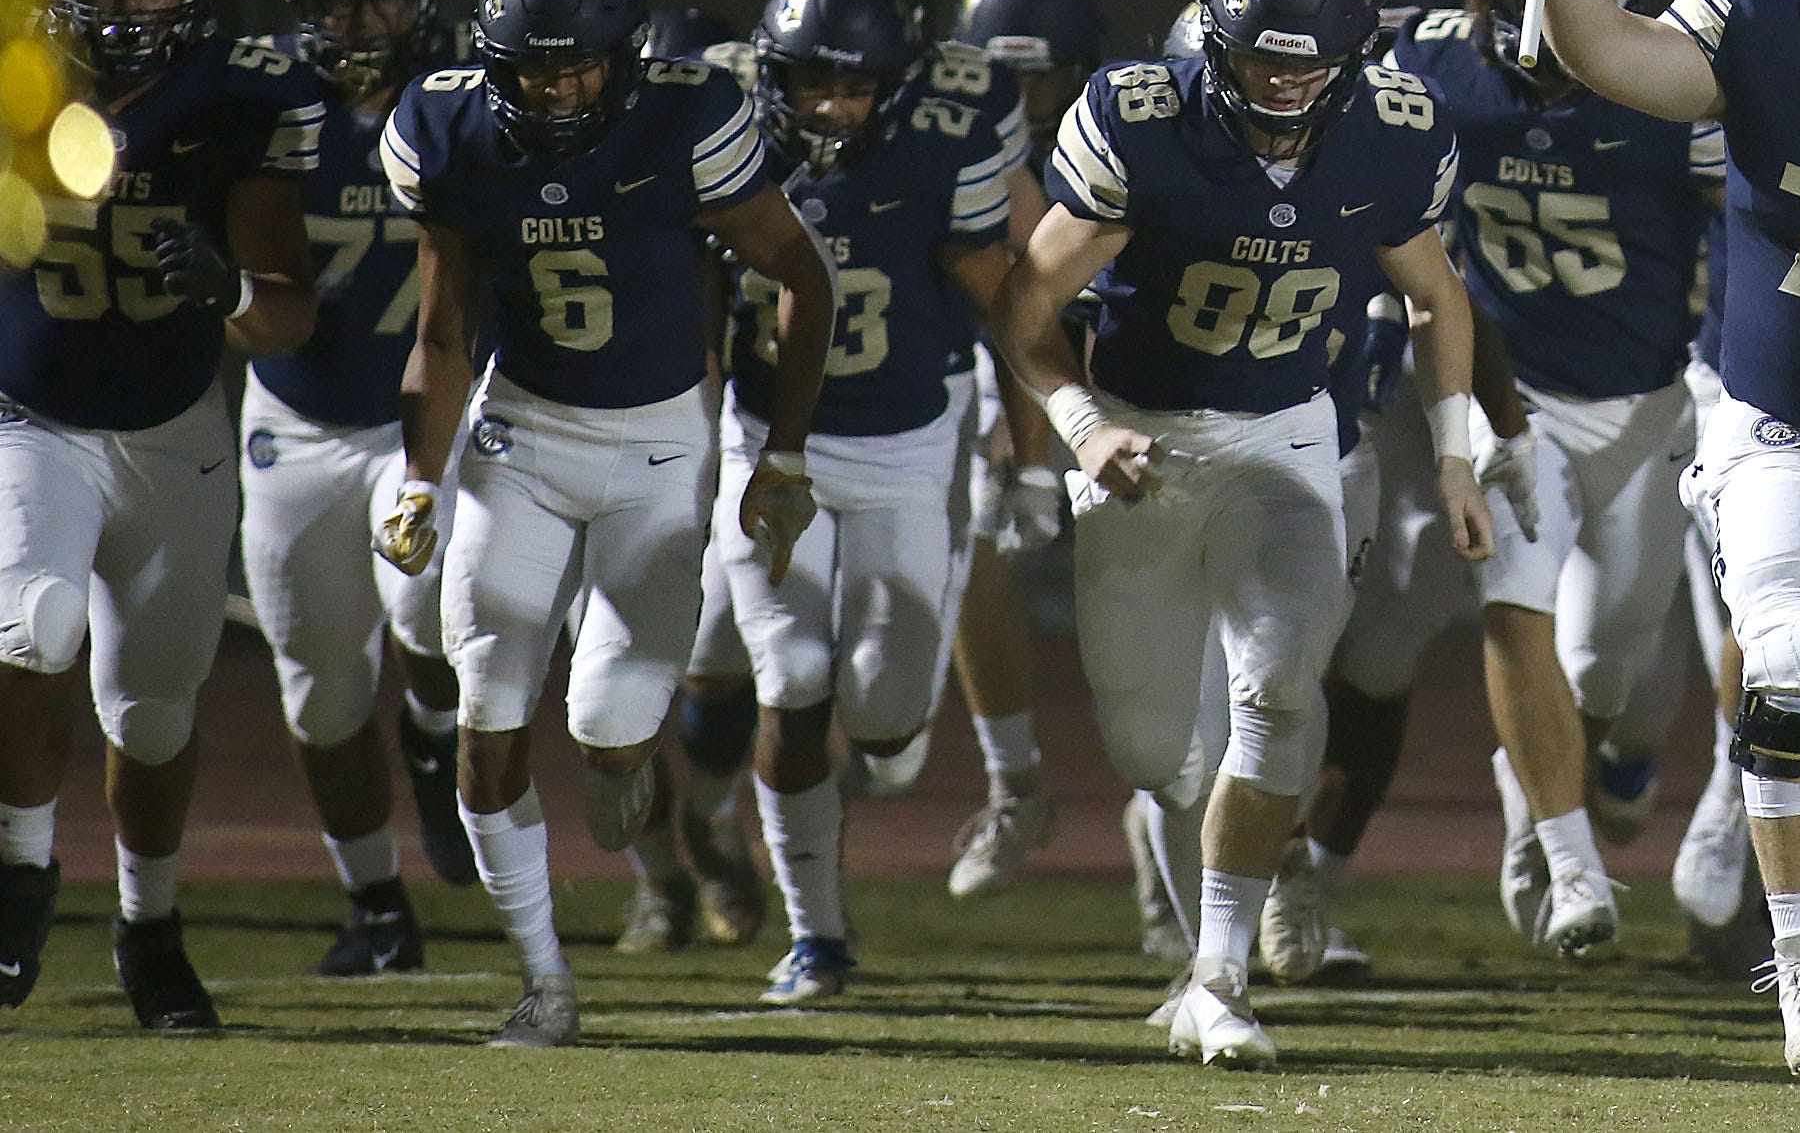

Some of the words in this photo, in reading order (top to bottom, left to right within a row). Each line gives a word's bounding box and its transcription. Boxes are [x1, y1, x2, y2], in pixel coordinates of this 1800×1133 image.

[1499, 155, 1574, 187] COLTS
[33, 198, 188, 323] 55
[303, 215, 421, 334] 77
[521, 215, 605, 244] COLTS
[1230, 235, 1313, 265] COLTS
[1463, 182, 1628, 296] 65
[528, 248, 614, 352] 6
[1166, 260, 1341, 360] 88
